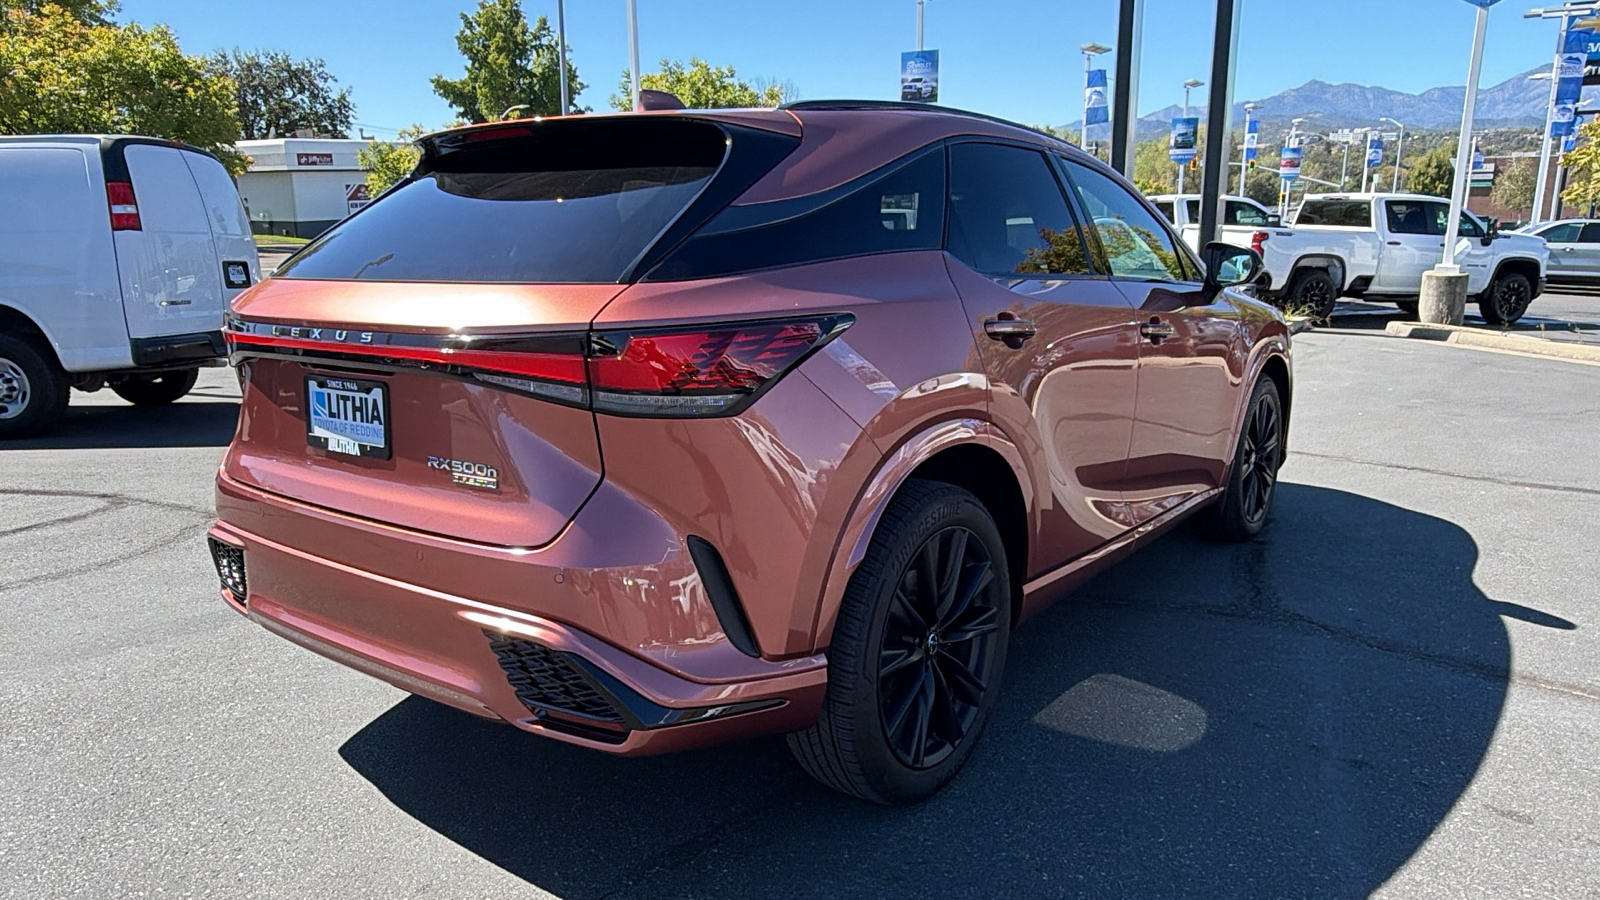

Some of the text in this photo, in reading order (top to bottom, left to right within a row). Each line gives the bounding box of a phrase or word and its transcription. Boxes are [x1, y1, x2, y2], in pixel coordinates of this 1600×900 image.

[272, 325, 373, 343] LEXUS
[326, 379, 358, 391] SINCE 1946
[326, 392, 383, 426] LITHIA
[313, 417, 339, 432] TOYOTA
[339, 421, 349, 433] OF
[891, 502, 961, 575] BRIDGESTONE
